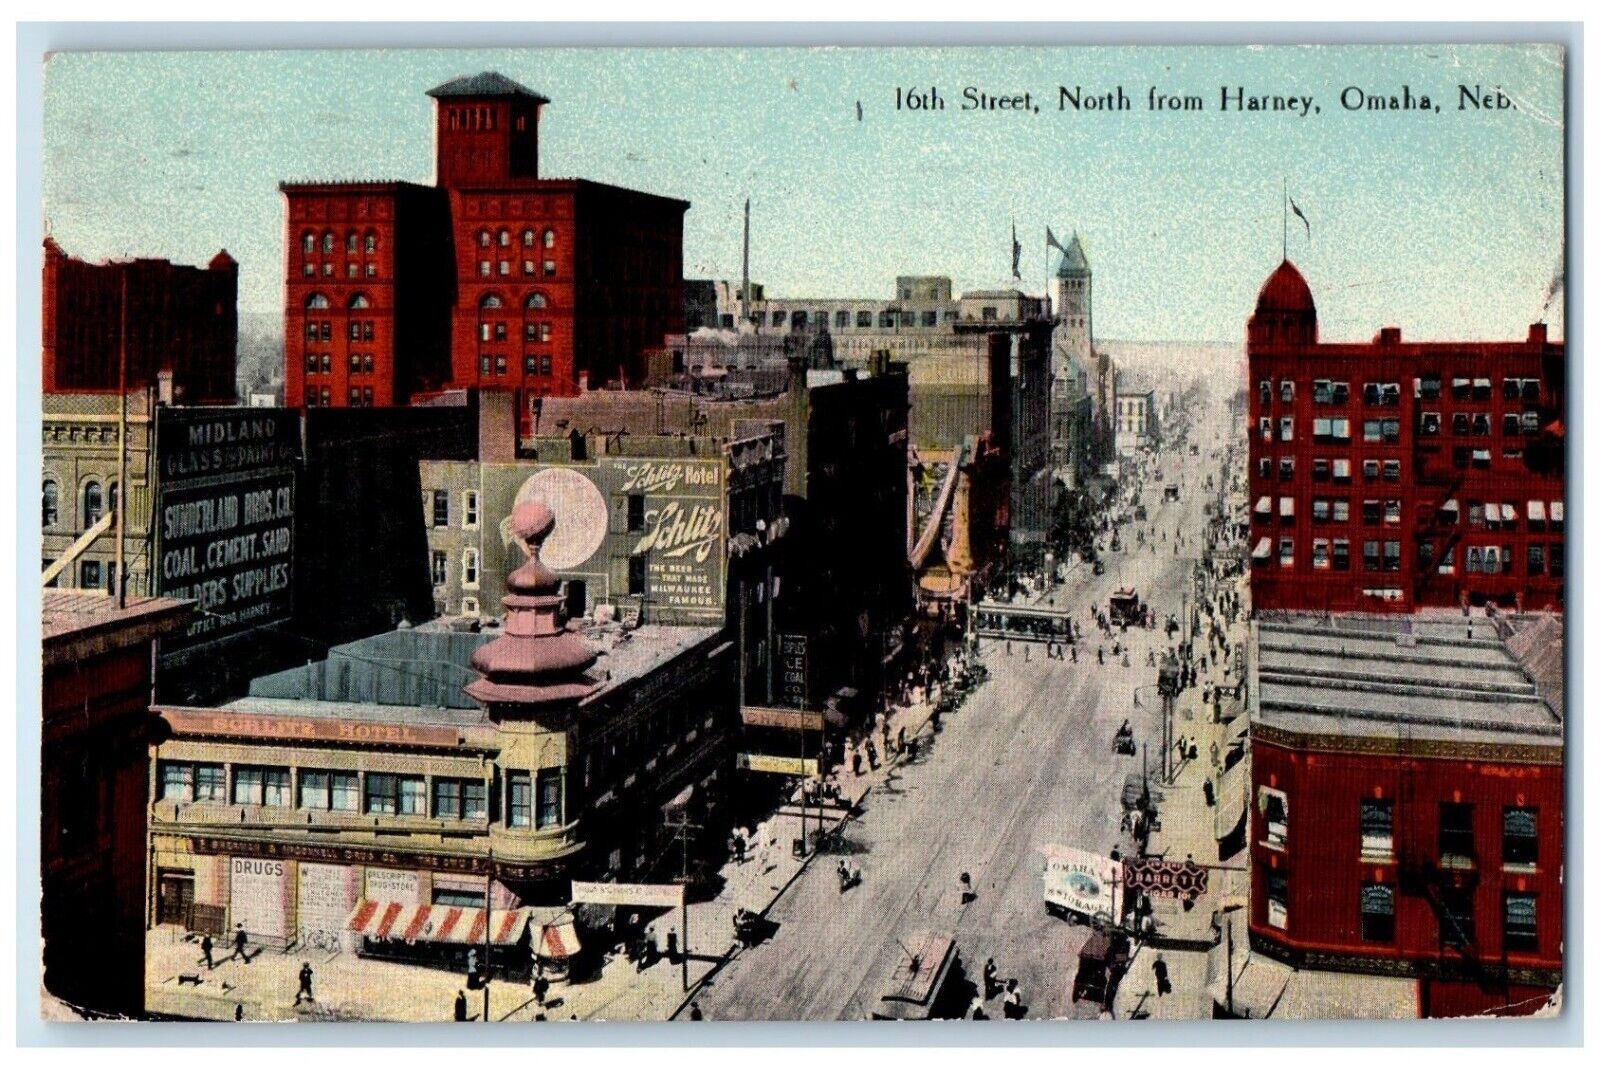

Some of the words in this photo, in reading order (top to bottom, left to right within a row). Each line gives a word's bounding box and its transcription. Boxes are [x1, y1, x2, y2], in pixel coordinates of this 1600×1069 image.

[188, 418, 276, 446] MIDLAND
[166, 448, 223, 477] GLASS
[621, 462, 684, 492] Schlitz
[685, 466, 719, 485] Hotel
[163, 495, 238, 540] SUNDERLAND
[262, 527, 290, 558] SAND
[632, 501, 722, 563] Schlitz
[231, 562, 289, 601] SUPPLIES
[651, 584, 712, 595] MILWAUKEE
[338, 722, 418, 741] HOTEL
[234, 860, 284, 877] DRUGS
[1052, 863, 1096, 877] OMAHA
[1135, 872, 1200, 888] BARRETT
